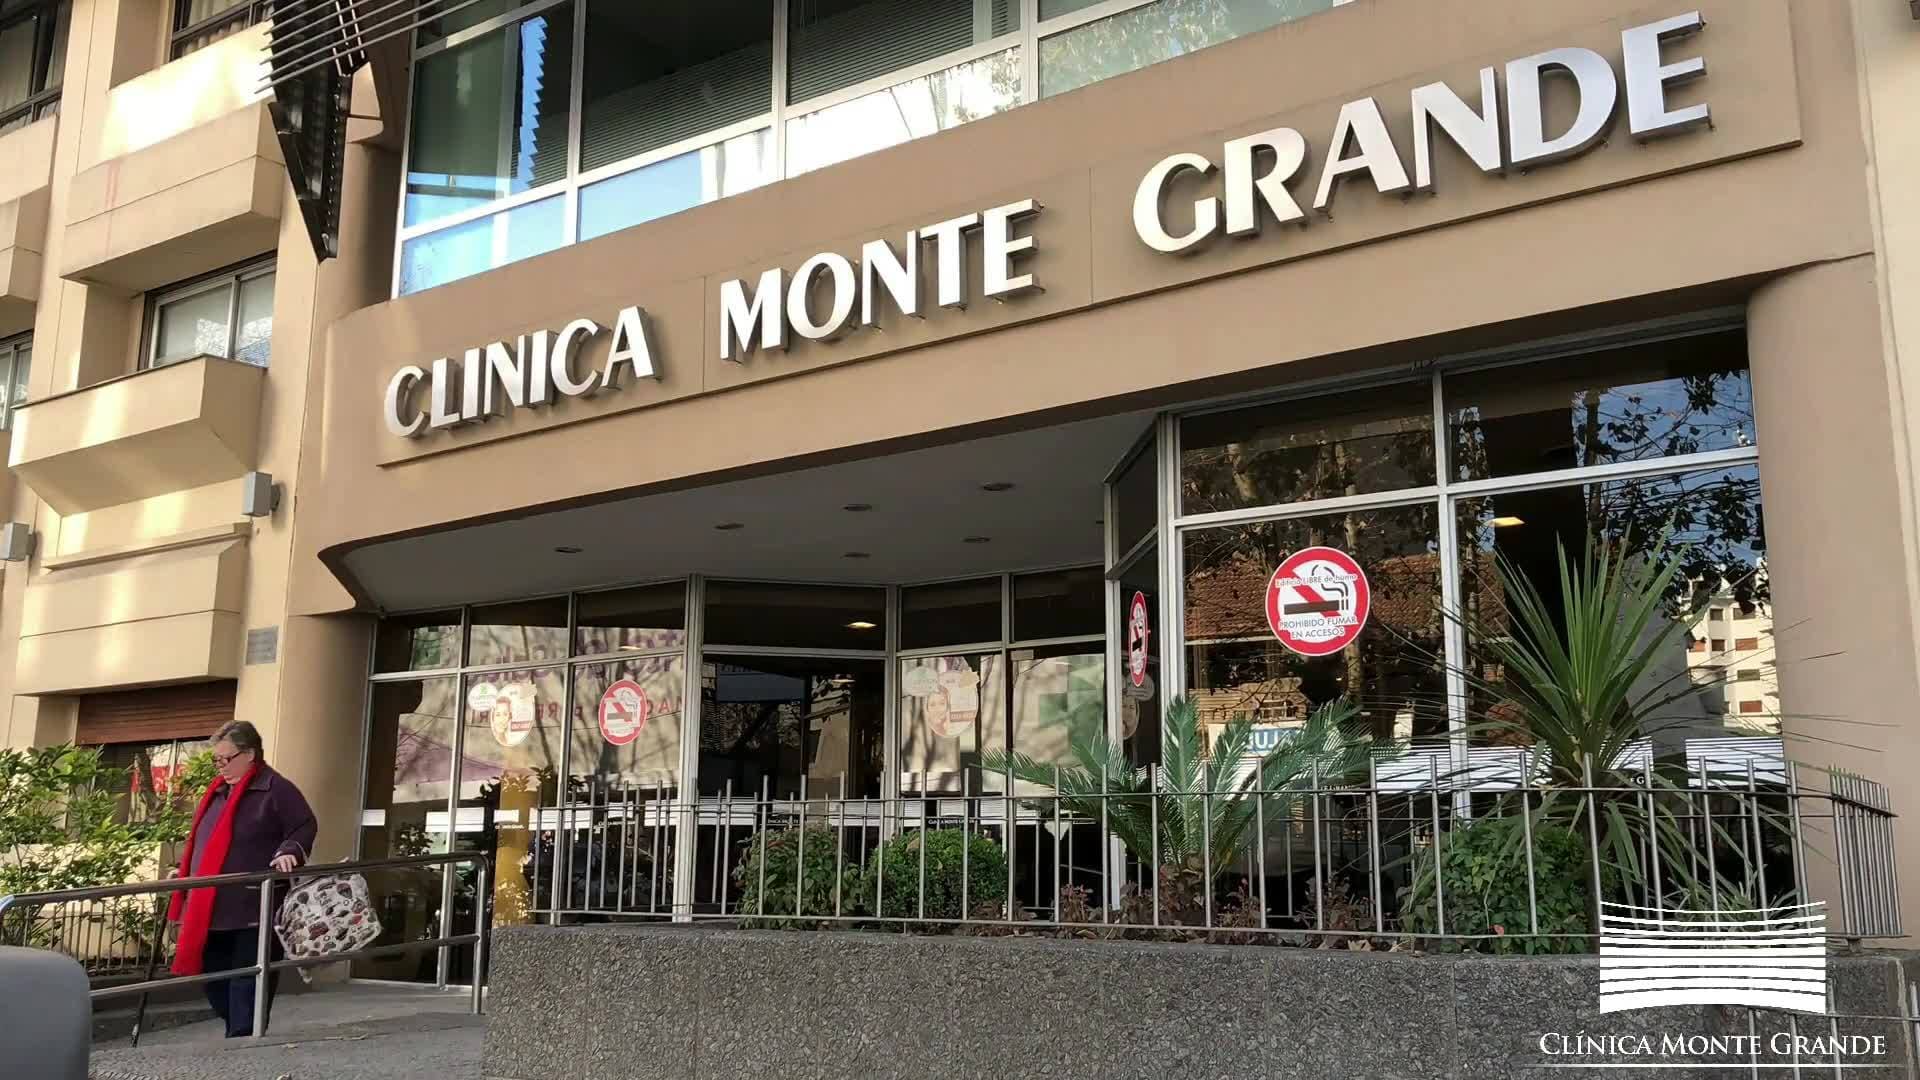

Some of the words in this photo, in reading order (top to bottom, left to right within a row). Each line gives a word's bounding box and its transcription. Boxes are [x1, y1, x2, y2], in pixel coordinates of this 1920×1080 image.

[383, 306, 660, 439] CLINICA
[720, 199, 1041, 362] MONTE
[1132, 10, 1711, 254] GRANDE
[1303, 576, 1321, 584] LIBRE
[1280, 618, 1325, 628] PROHIBIDO
[1327, 617, 1356, 626] FUMAR
[1305, 628, 1345, 638] ACCESOS
